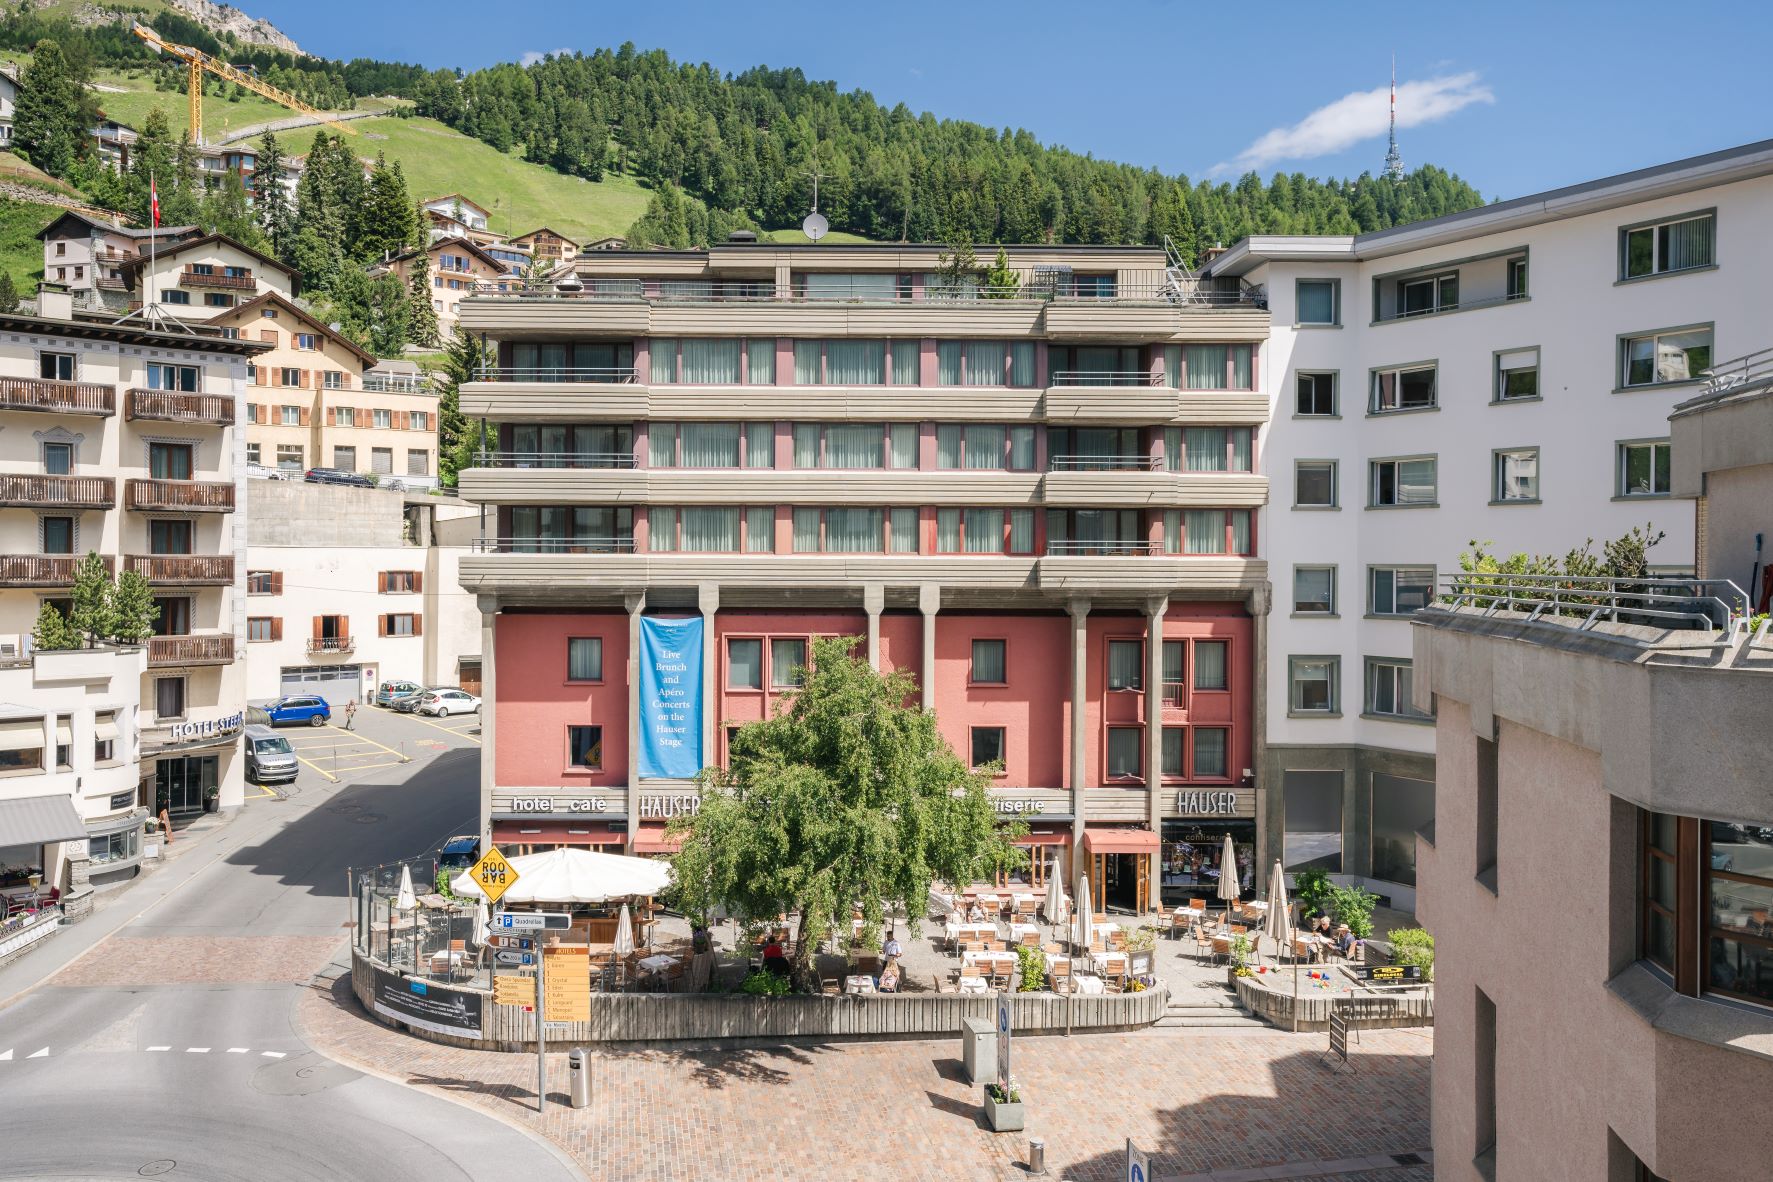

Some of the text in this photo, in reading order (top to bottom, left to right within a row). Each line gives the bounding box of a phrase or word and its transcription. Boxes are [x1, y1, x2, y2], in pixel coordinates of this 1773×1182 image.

[663, 650, 681, 659] Live
[656, 662, 687, 671] Brunch
[663, 675, 679, 684] and
[658, 688, 685, 698] Apéro
[652, 700, 690, 709] Concerts
[658, 713, 685, 721] on the
[171, 720, 215, 738] HOTEL
[656, 725, 686, 733] Hauser
[660, 737, 682, 748] Stage
[513, 796, 607, 811] hotel café
[640, 795, 701, 818] HAUSER
[1177, 791, 1236, 814] HAUSER
[482, 861, 505, 873] ROO
[482, 872, 506, 884] BAR
